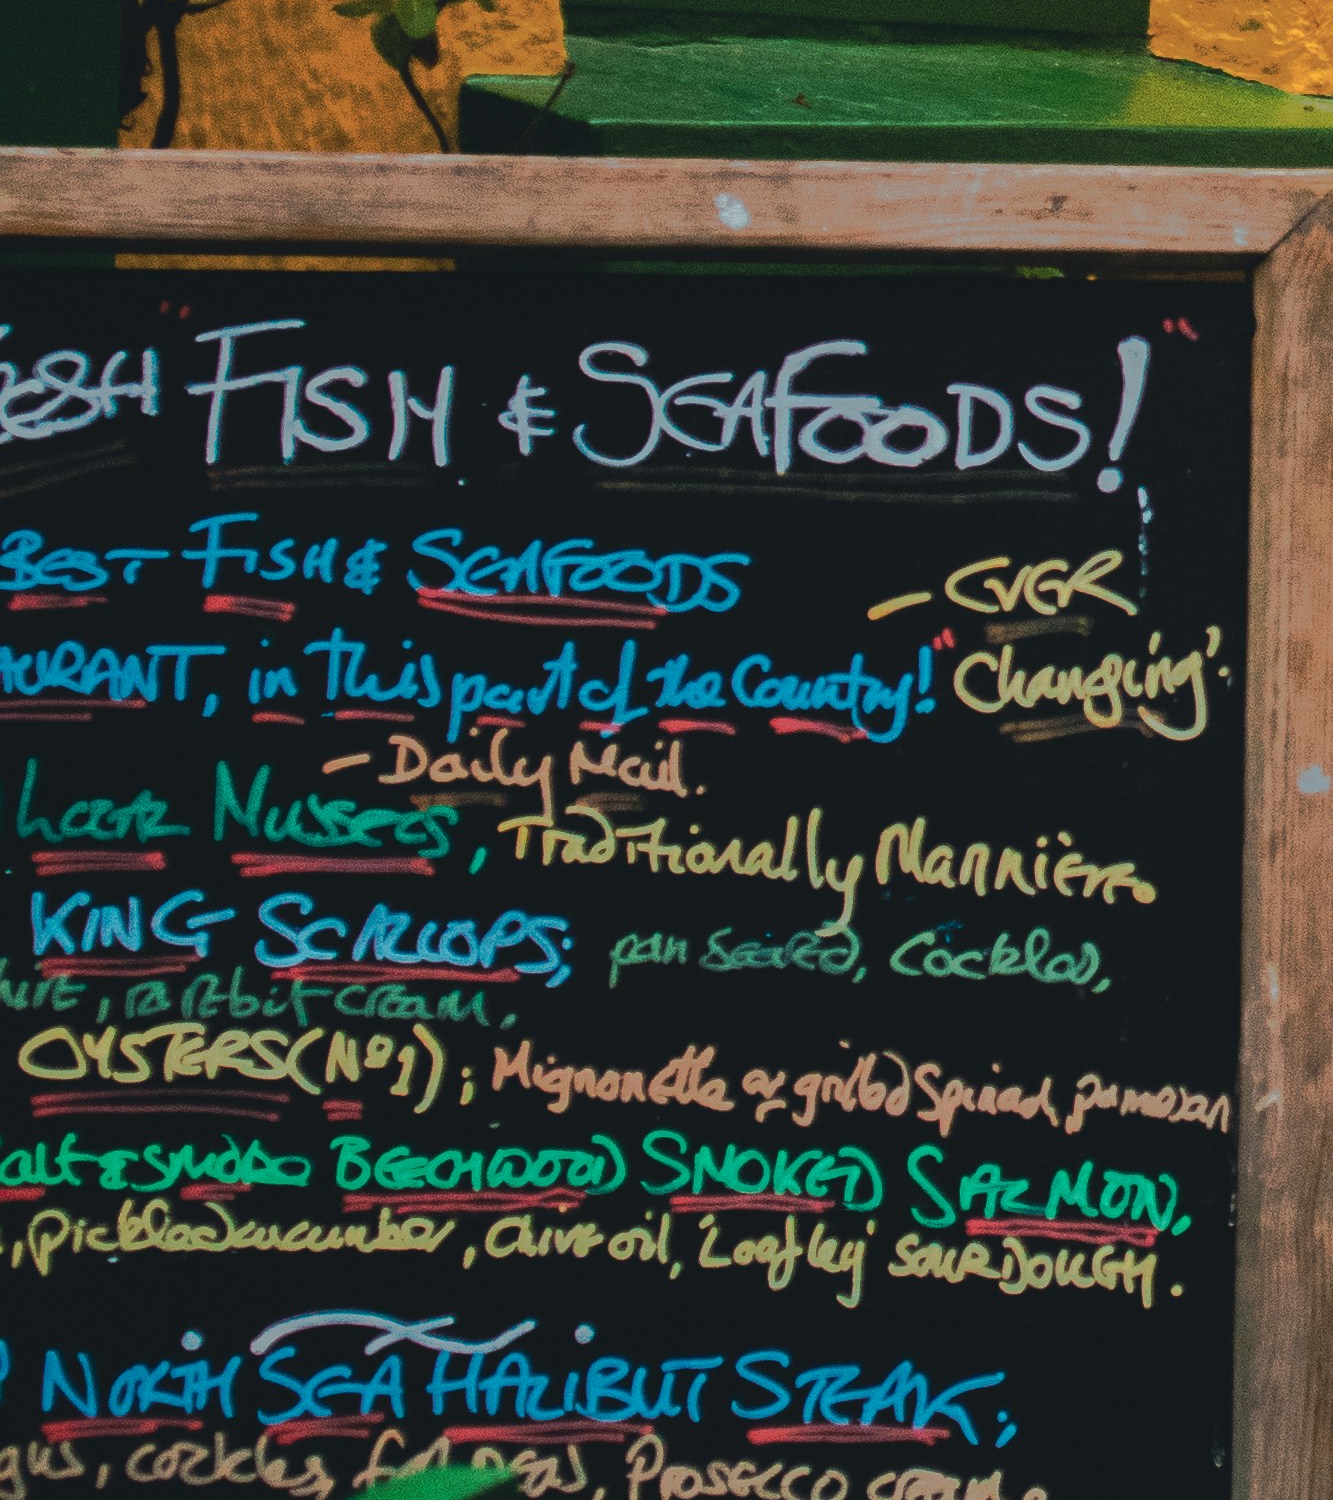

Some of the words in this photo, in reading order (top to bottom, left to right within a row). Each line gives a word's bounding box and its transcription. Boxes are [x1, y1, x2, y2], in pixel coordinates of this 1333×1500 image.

[407, 528, 752, 614] SEAFOODS
[247, 637, 298, 706] in
[30, 888, 236, 960] KING
[641, 1129, 884, 1211] SMOKED
[40, 1349, 242, 1418] NORTH
[257, 1347, 405, 1424] SEA
[426, 1348, 724, 1422] HALIBUT
